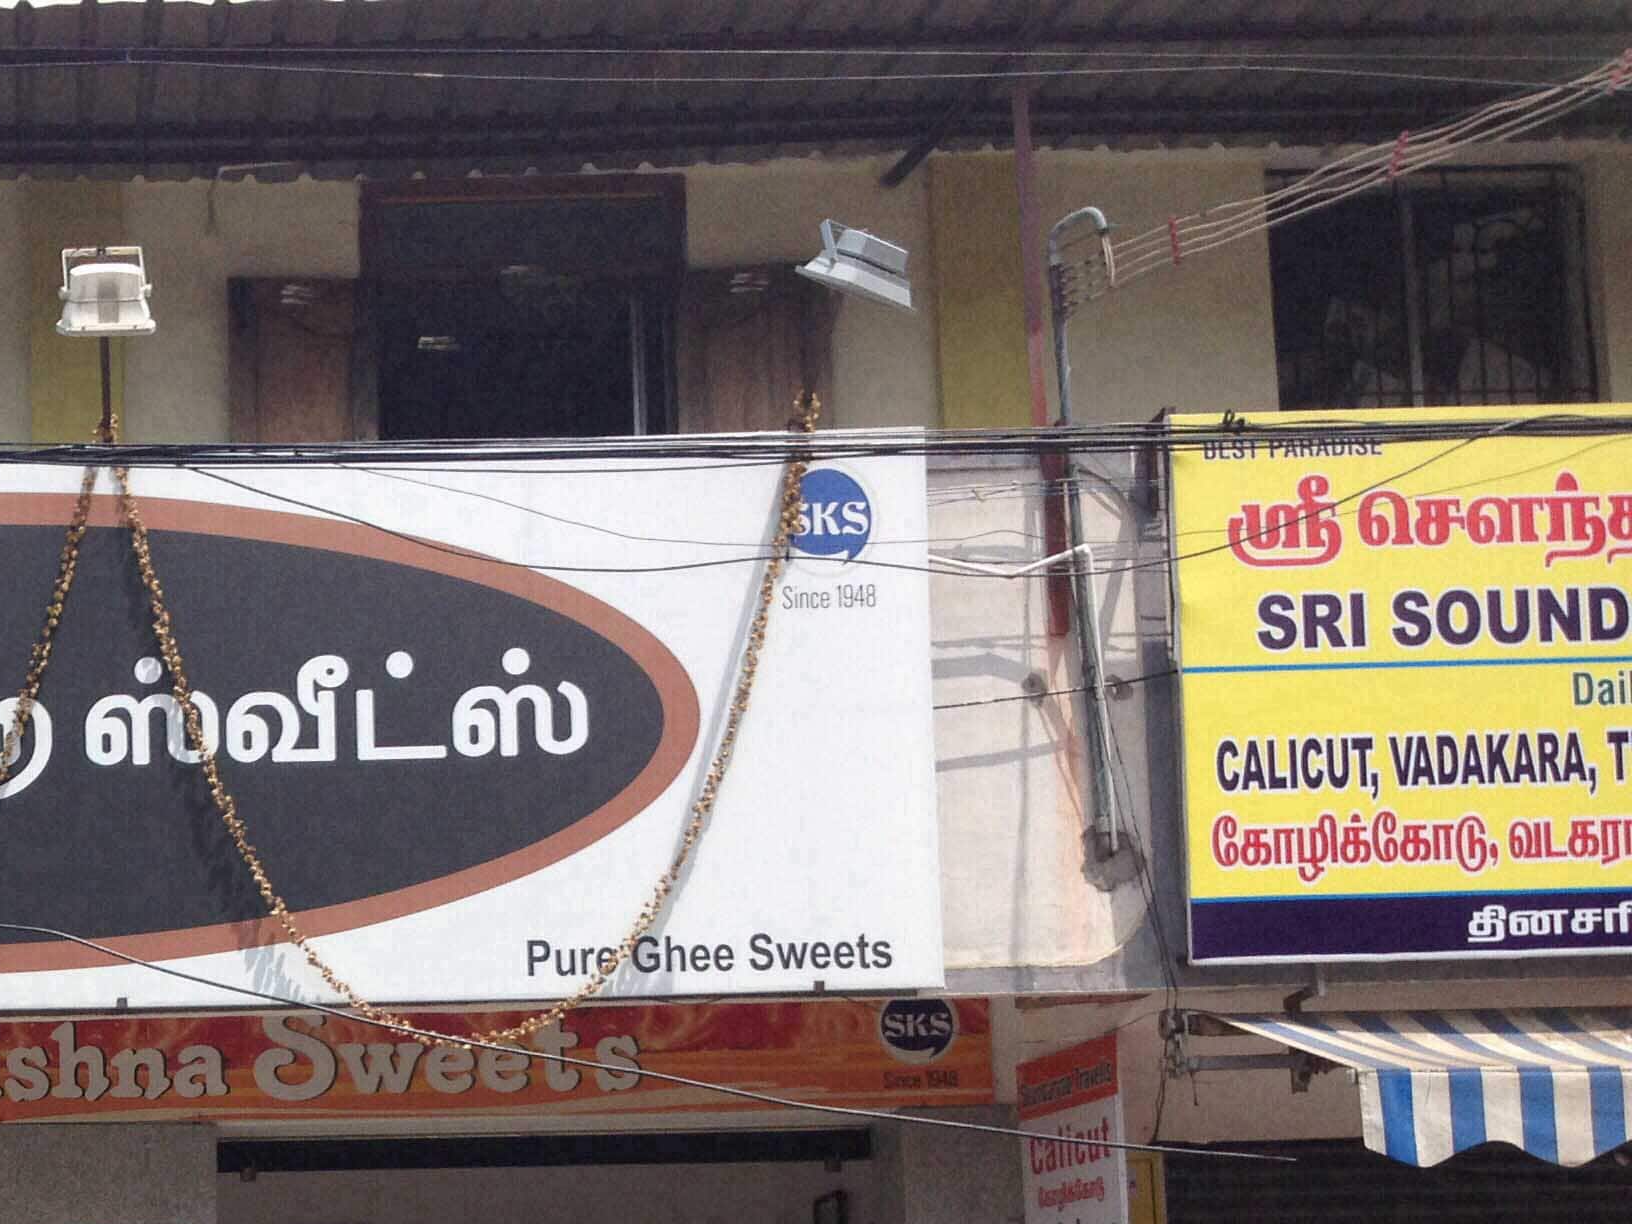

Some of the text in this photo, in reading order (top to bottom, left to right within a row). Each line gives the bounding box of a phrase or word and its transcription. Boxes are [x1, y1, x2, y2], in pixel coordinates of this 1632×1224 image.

[781, 584, 877, 610] Since 1948
[1257, 585, 1631, 651] SRI SOUND
[1216, 736, 1380, 798] CALICUT,
[1389, 731, 1598, 796] VADAKARA,
[526, 932, 894, 977] Pure Ghee Sweets
[883, 1012, 952, 1039] SKS
[255, 1012, 645, 1100] Sweets
[1029, 1117, 1112, 1176] Calicut
